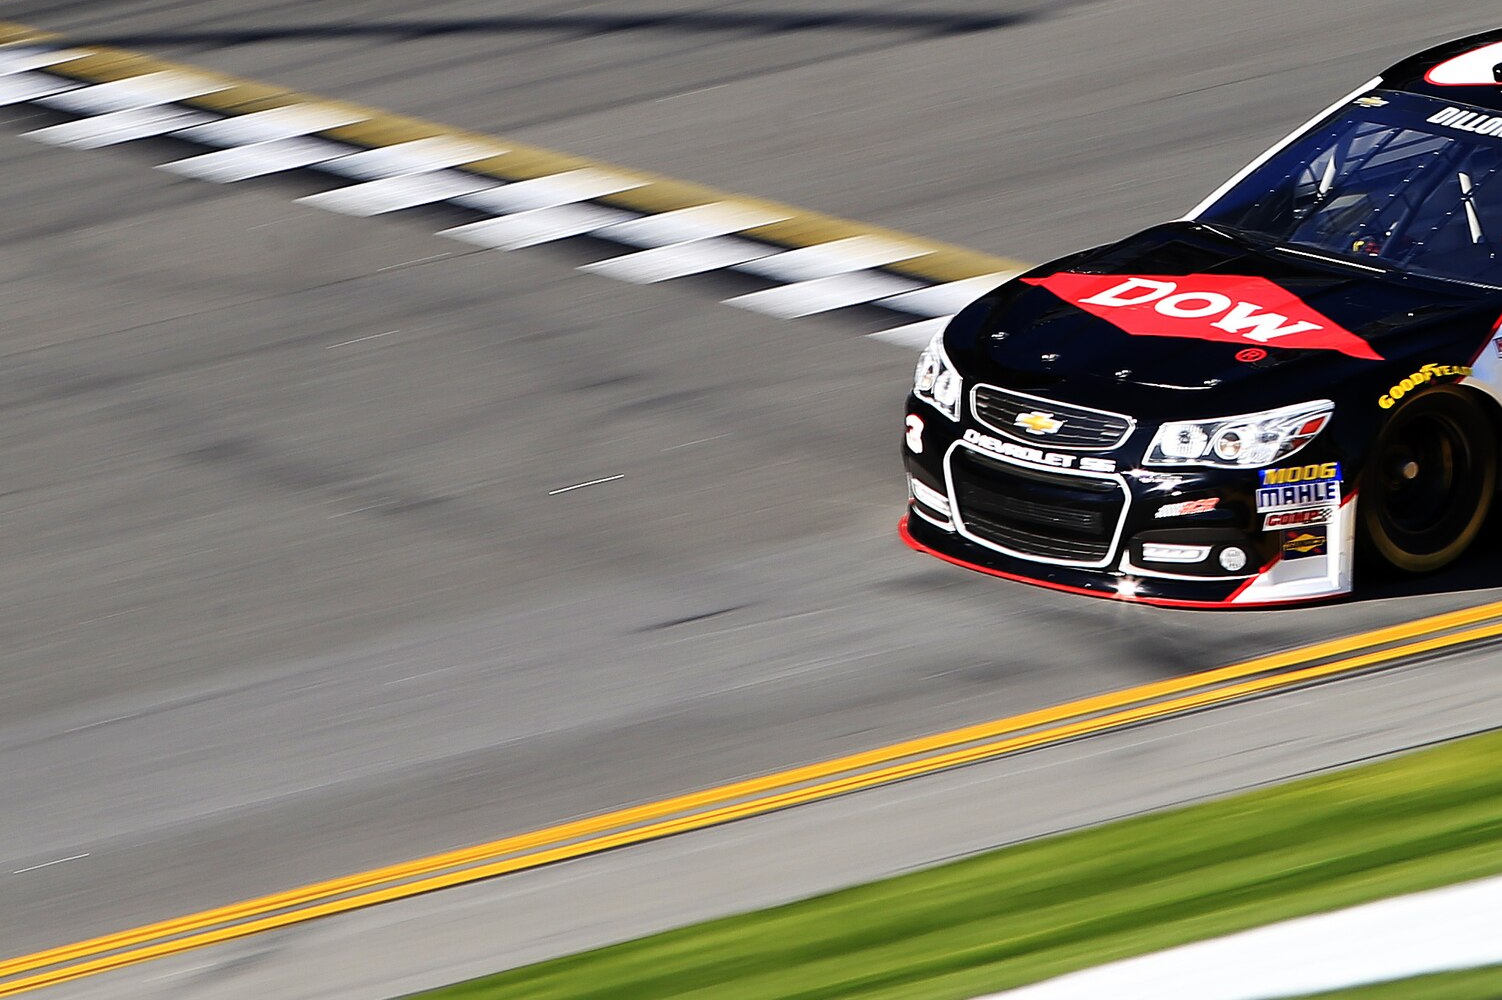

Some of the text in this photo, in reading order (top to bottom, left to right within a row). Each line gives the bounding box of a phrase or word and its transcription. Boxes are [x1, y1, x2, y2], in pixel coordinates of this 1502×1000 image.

[1080, 278, 1322, 342] DOW
[1378, 363, 1473, 409] GOODYEAR
[905, 413, 924, 454] 3
[962, 429, 1077, 468] CHEVROLET
[1262, 462, 1338, 484] MOOG
[1258, 482, 1336, 507] MAHLE
